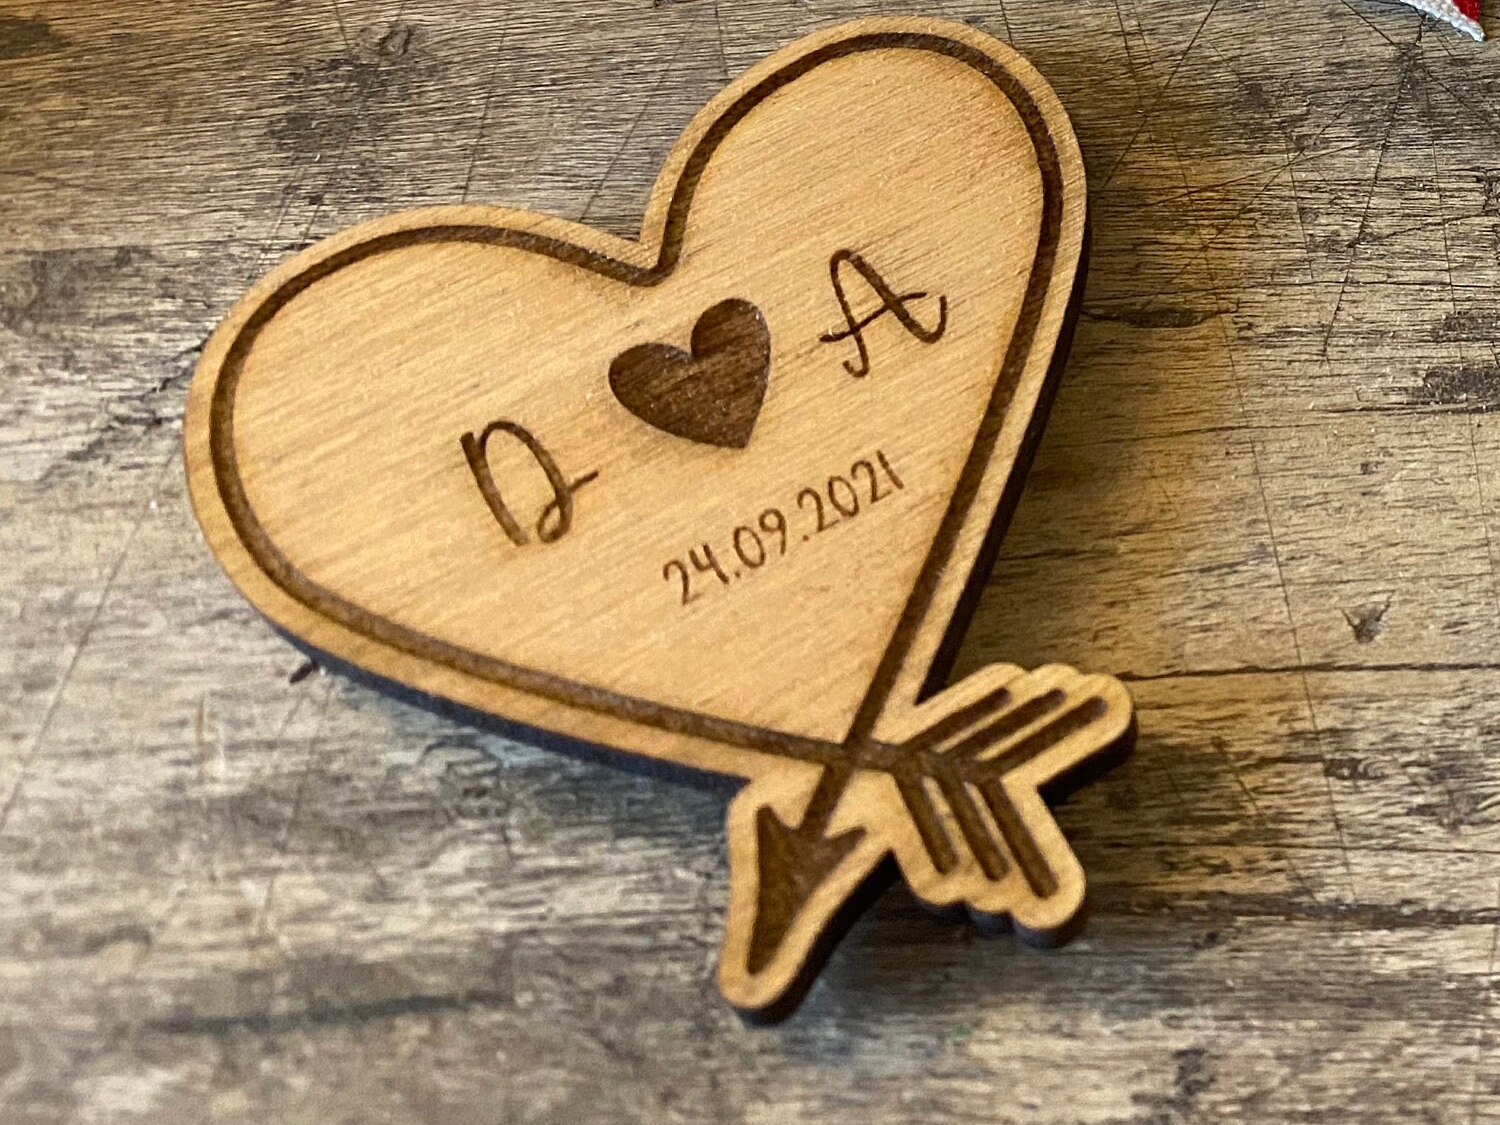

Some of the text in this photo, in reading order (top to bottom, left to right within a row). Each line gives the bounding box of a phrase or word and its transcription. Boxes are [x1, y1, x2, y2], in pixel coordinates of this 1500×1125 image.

[460, 248, 948, 547] D A
[662, 450, 904, 606] 24.09.2021
